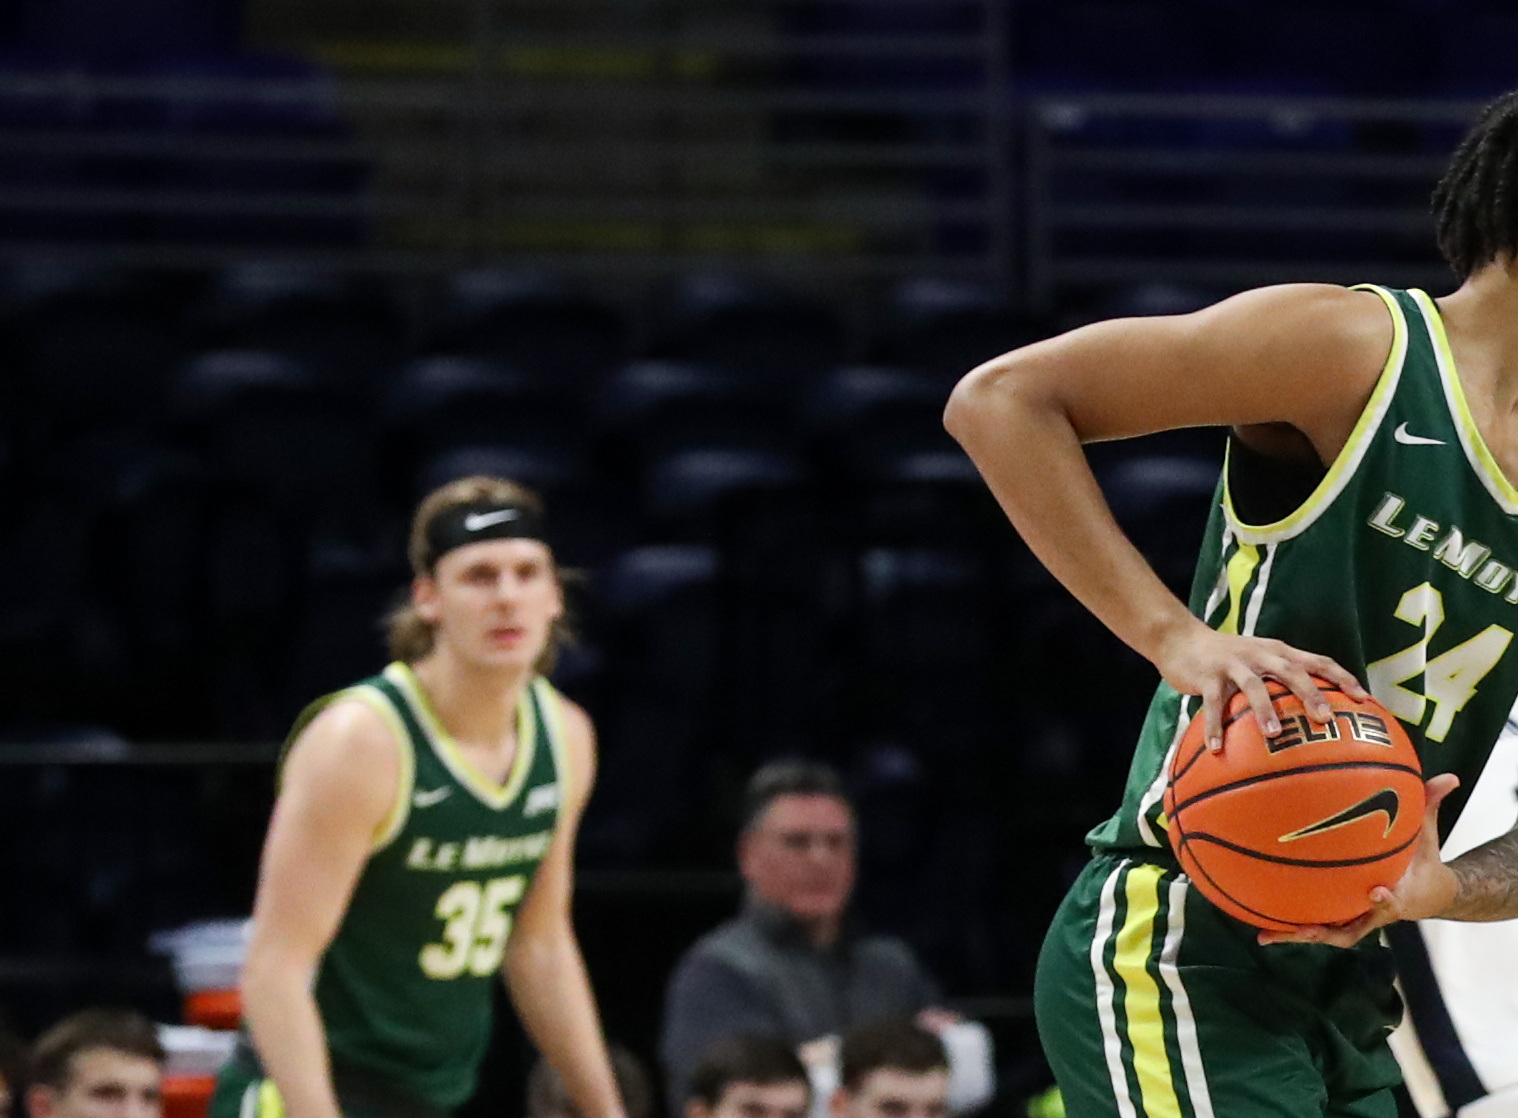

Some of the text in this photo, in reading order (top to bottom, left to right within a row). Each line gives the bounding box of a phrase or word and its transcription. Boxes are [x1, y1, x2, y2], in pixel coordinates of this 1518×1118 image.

[1366, 581, 1514, 743] 24
[1265, 711, 1393, 755] ELITE
[417, 875, 528, 981] 35
